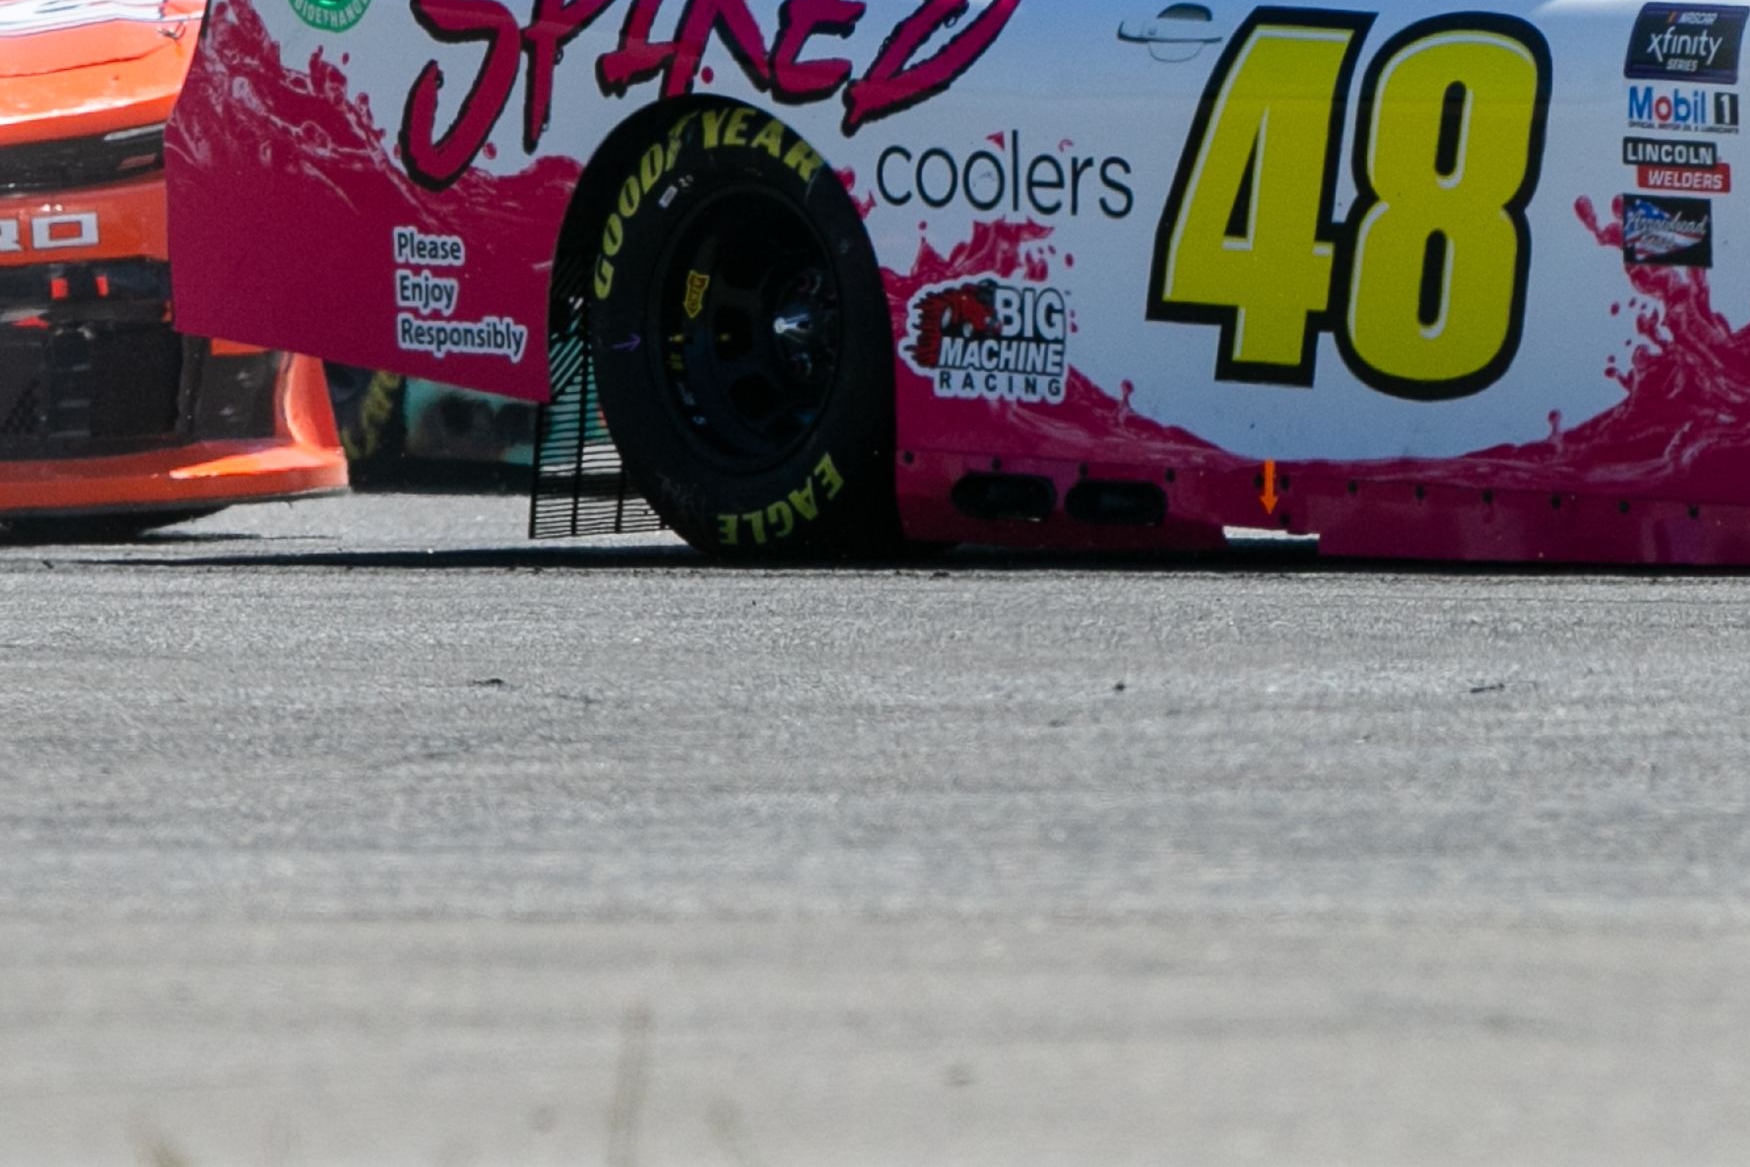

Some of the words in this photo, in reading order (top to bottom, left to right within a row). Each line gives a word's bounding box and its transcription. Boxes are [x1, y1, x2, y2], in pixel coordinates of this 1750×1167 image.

[1647, 26, 1723, 65] xfinity
[1666, 58, 1699, 72] SERIES
[1628, 86, 1706, 124] Mobil
[1717, 93, 1734, 125] 1
[1626, 142, 1714, 165] LINCOLN
[877, 130, 1133, 218] coolers
[1647, 170, 1723, 190] WELDERS
[594, 107, 824, 300] GOODYEAR
[1146, 5, 1553, 401] 48
[396, 231, 462, 261] Please
[398, 274, 456, 311] Enjoy
[994, 285, 1065, 341] BIG
[400, 317, 525, 358] Responsibly
[938, 335, 1065, 377] MACHINE
[939, 370, 1062, 397] RACING
[716, 451, 845, 546] EAGLE
